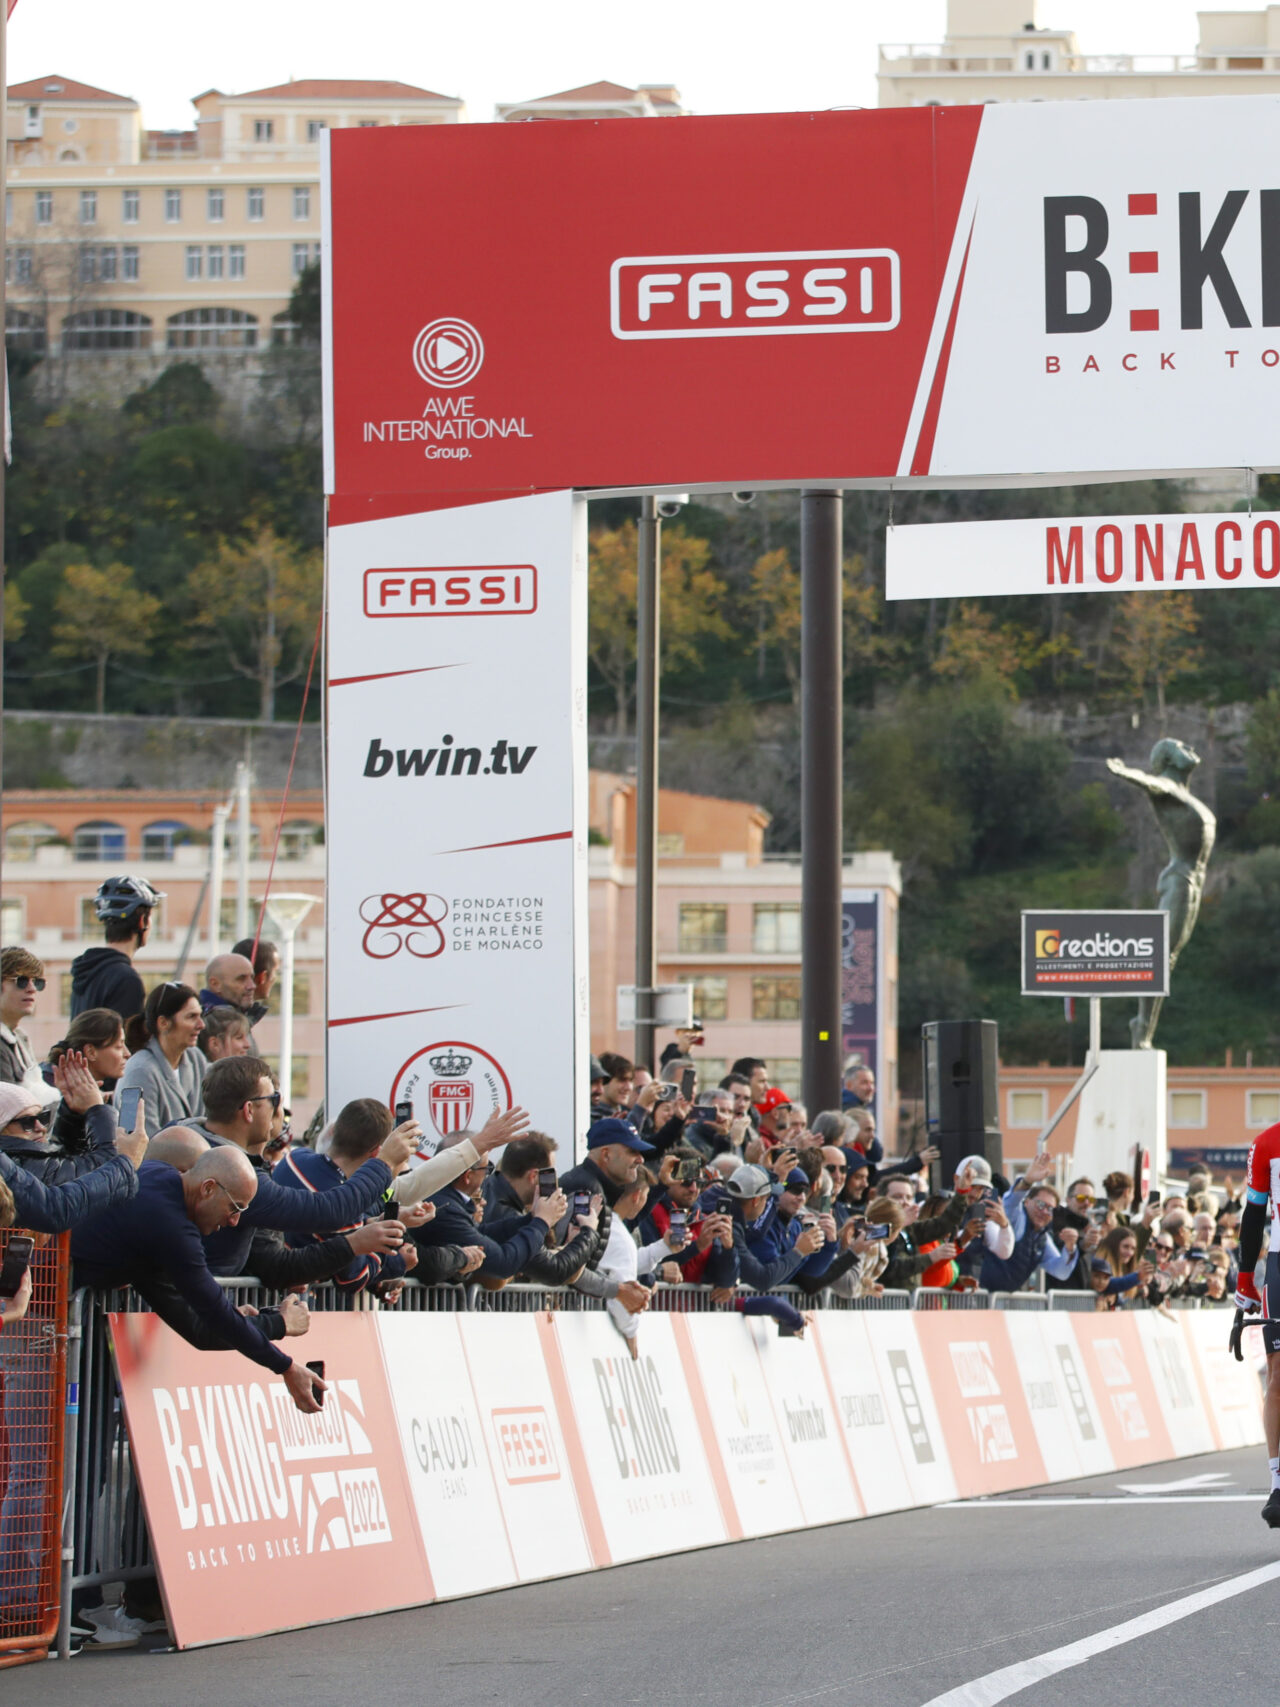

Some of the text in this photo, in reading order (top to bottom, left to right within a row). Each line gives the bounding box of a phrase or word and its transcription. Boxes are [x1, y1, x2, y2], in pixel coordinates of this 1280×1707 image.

[638, 266, 873, 322] FASSI
[1045, 352, 1177, 374] BACK
[1225, 349, 1280, 368] TO
[422, 396, 475, 417] AWE
[363, 418, 533, 444] INTERNATIONAL
[424, 444, 472, 461] Group.
[380, 576, 520, 607] FASSI
[363, 734, 538, 778] bwin.tv
[453, 897, 543, 909] FONDATION
[453, 911, 543, 922] PRINCESSE
[453, 924, 543, 937] CHARLÈNE
[453, 939, 543, 951] DE MONACO
[1036, 962, 1084, 970] ALLESTIMENTI
[1096, 961, 1153, 969] PROGETTAZIONE
[439, 1086, 466, 1097] FMC
[501, 1422, 552, 1468] FASSI
[344, 1480, 386, 1534] 2022
[188, 1537, 301, 1570] BACK TO BIKE
